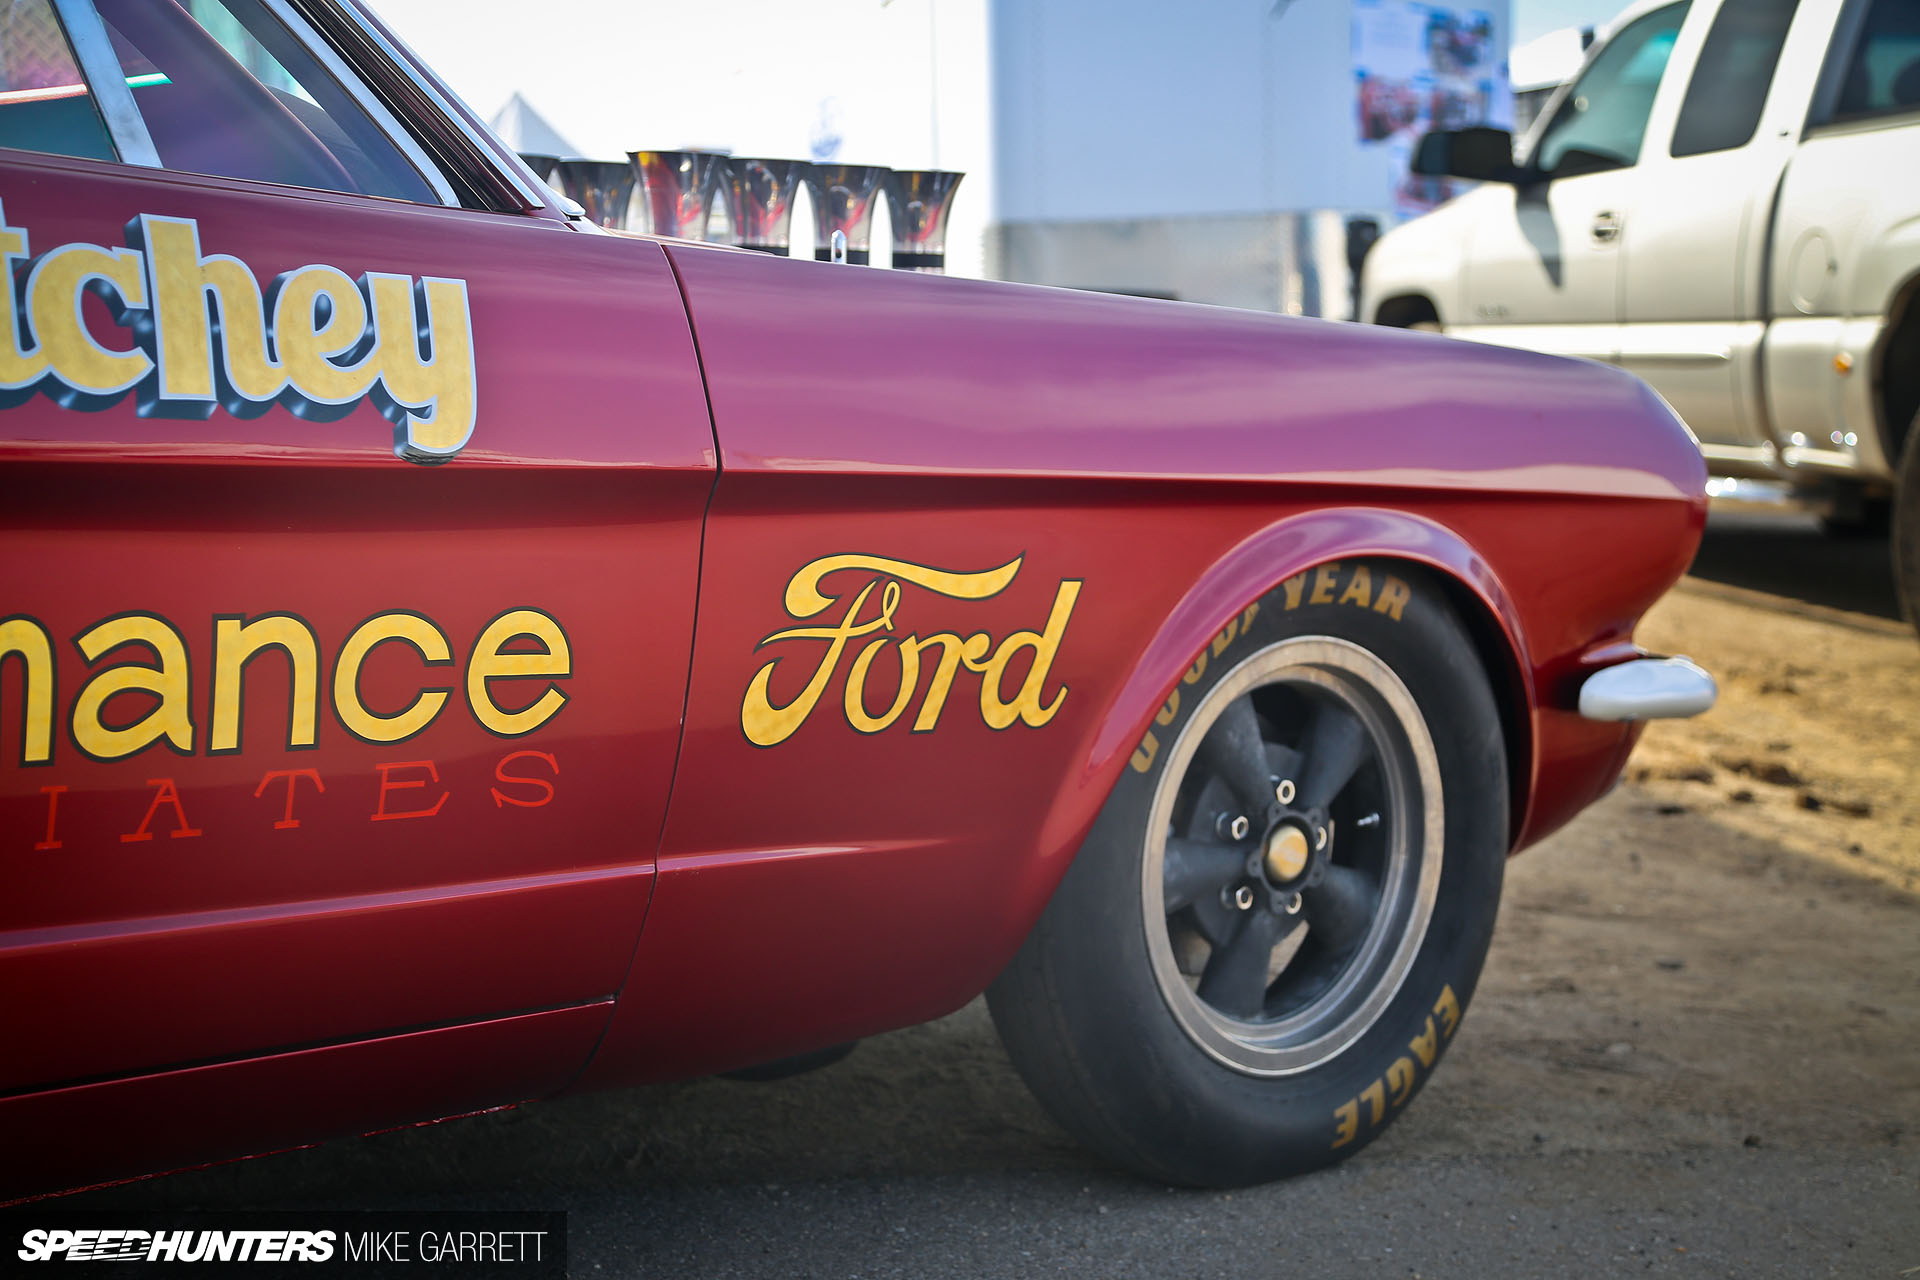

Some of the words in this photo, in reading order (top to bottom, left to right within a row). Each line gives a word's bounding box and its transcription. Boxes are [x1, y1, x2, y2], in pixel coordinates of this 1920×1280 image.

[740, 549, 1086, 749] Ford
[34, 750, 560, 851] IATES
[1331, 984, 1460, 1149] EAGLE
